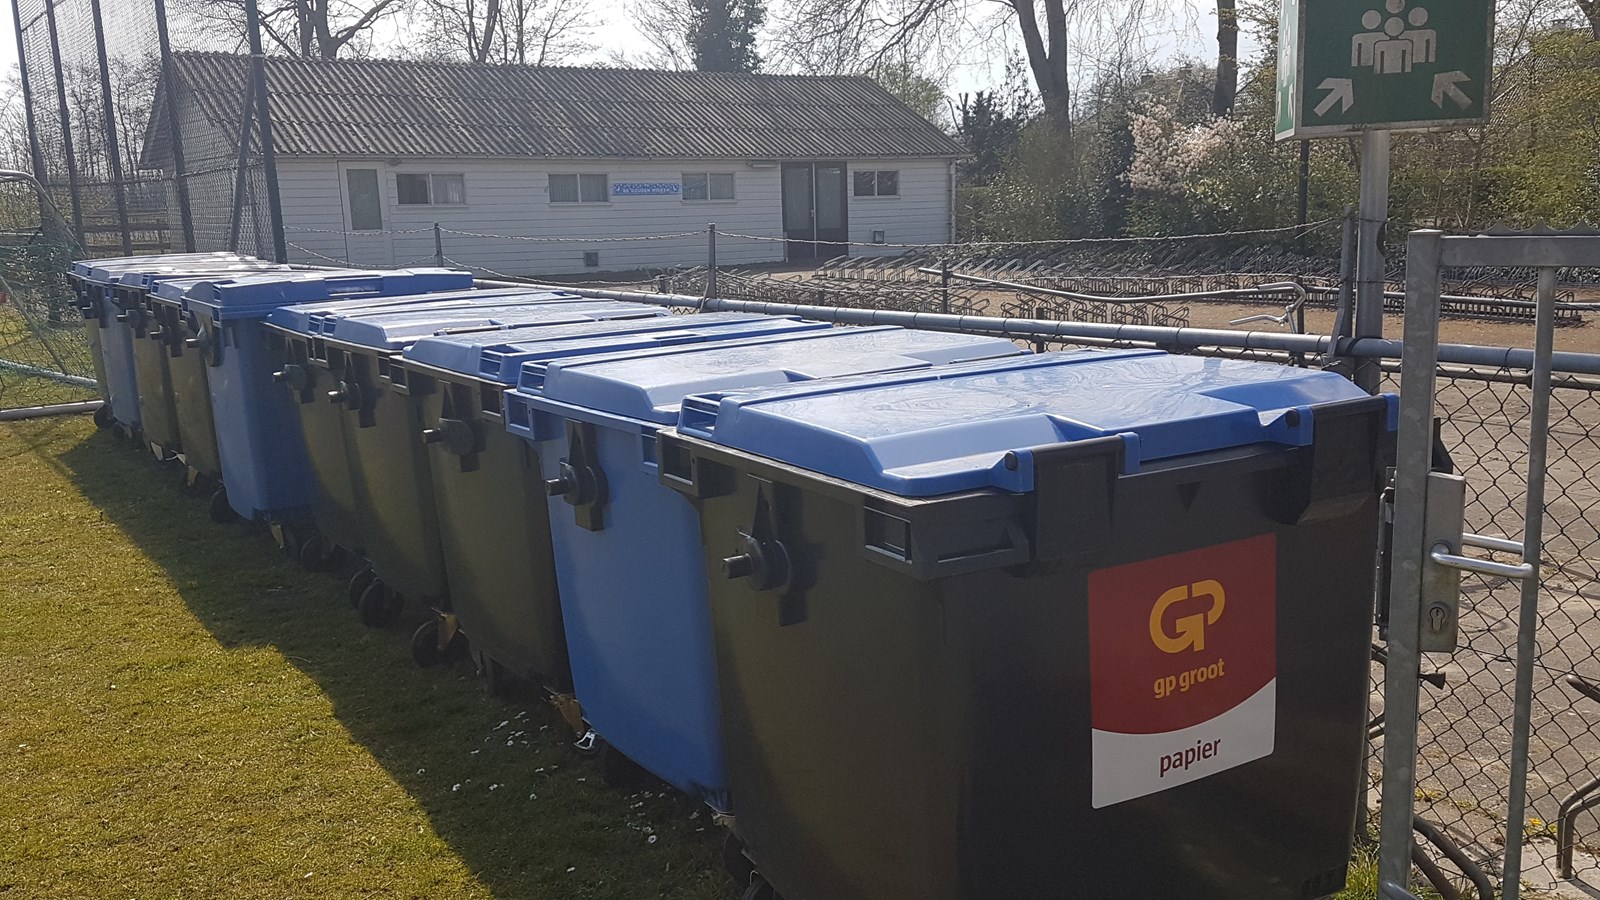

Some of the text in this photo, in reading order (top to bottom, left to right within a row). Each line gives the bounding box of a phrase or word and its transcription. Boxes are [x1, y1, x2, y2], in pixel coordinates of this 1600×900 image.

[1153, 658, 1225, 699] gp groot
[1159, 738, 1221, 778] papier
